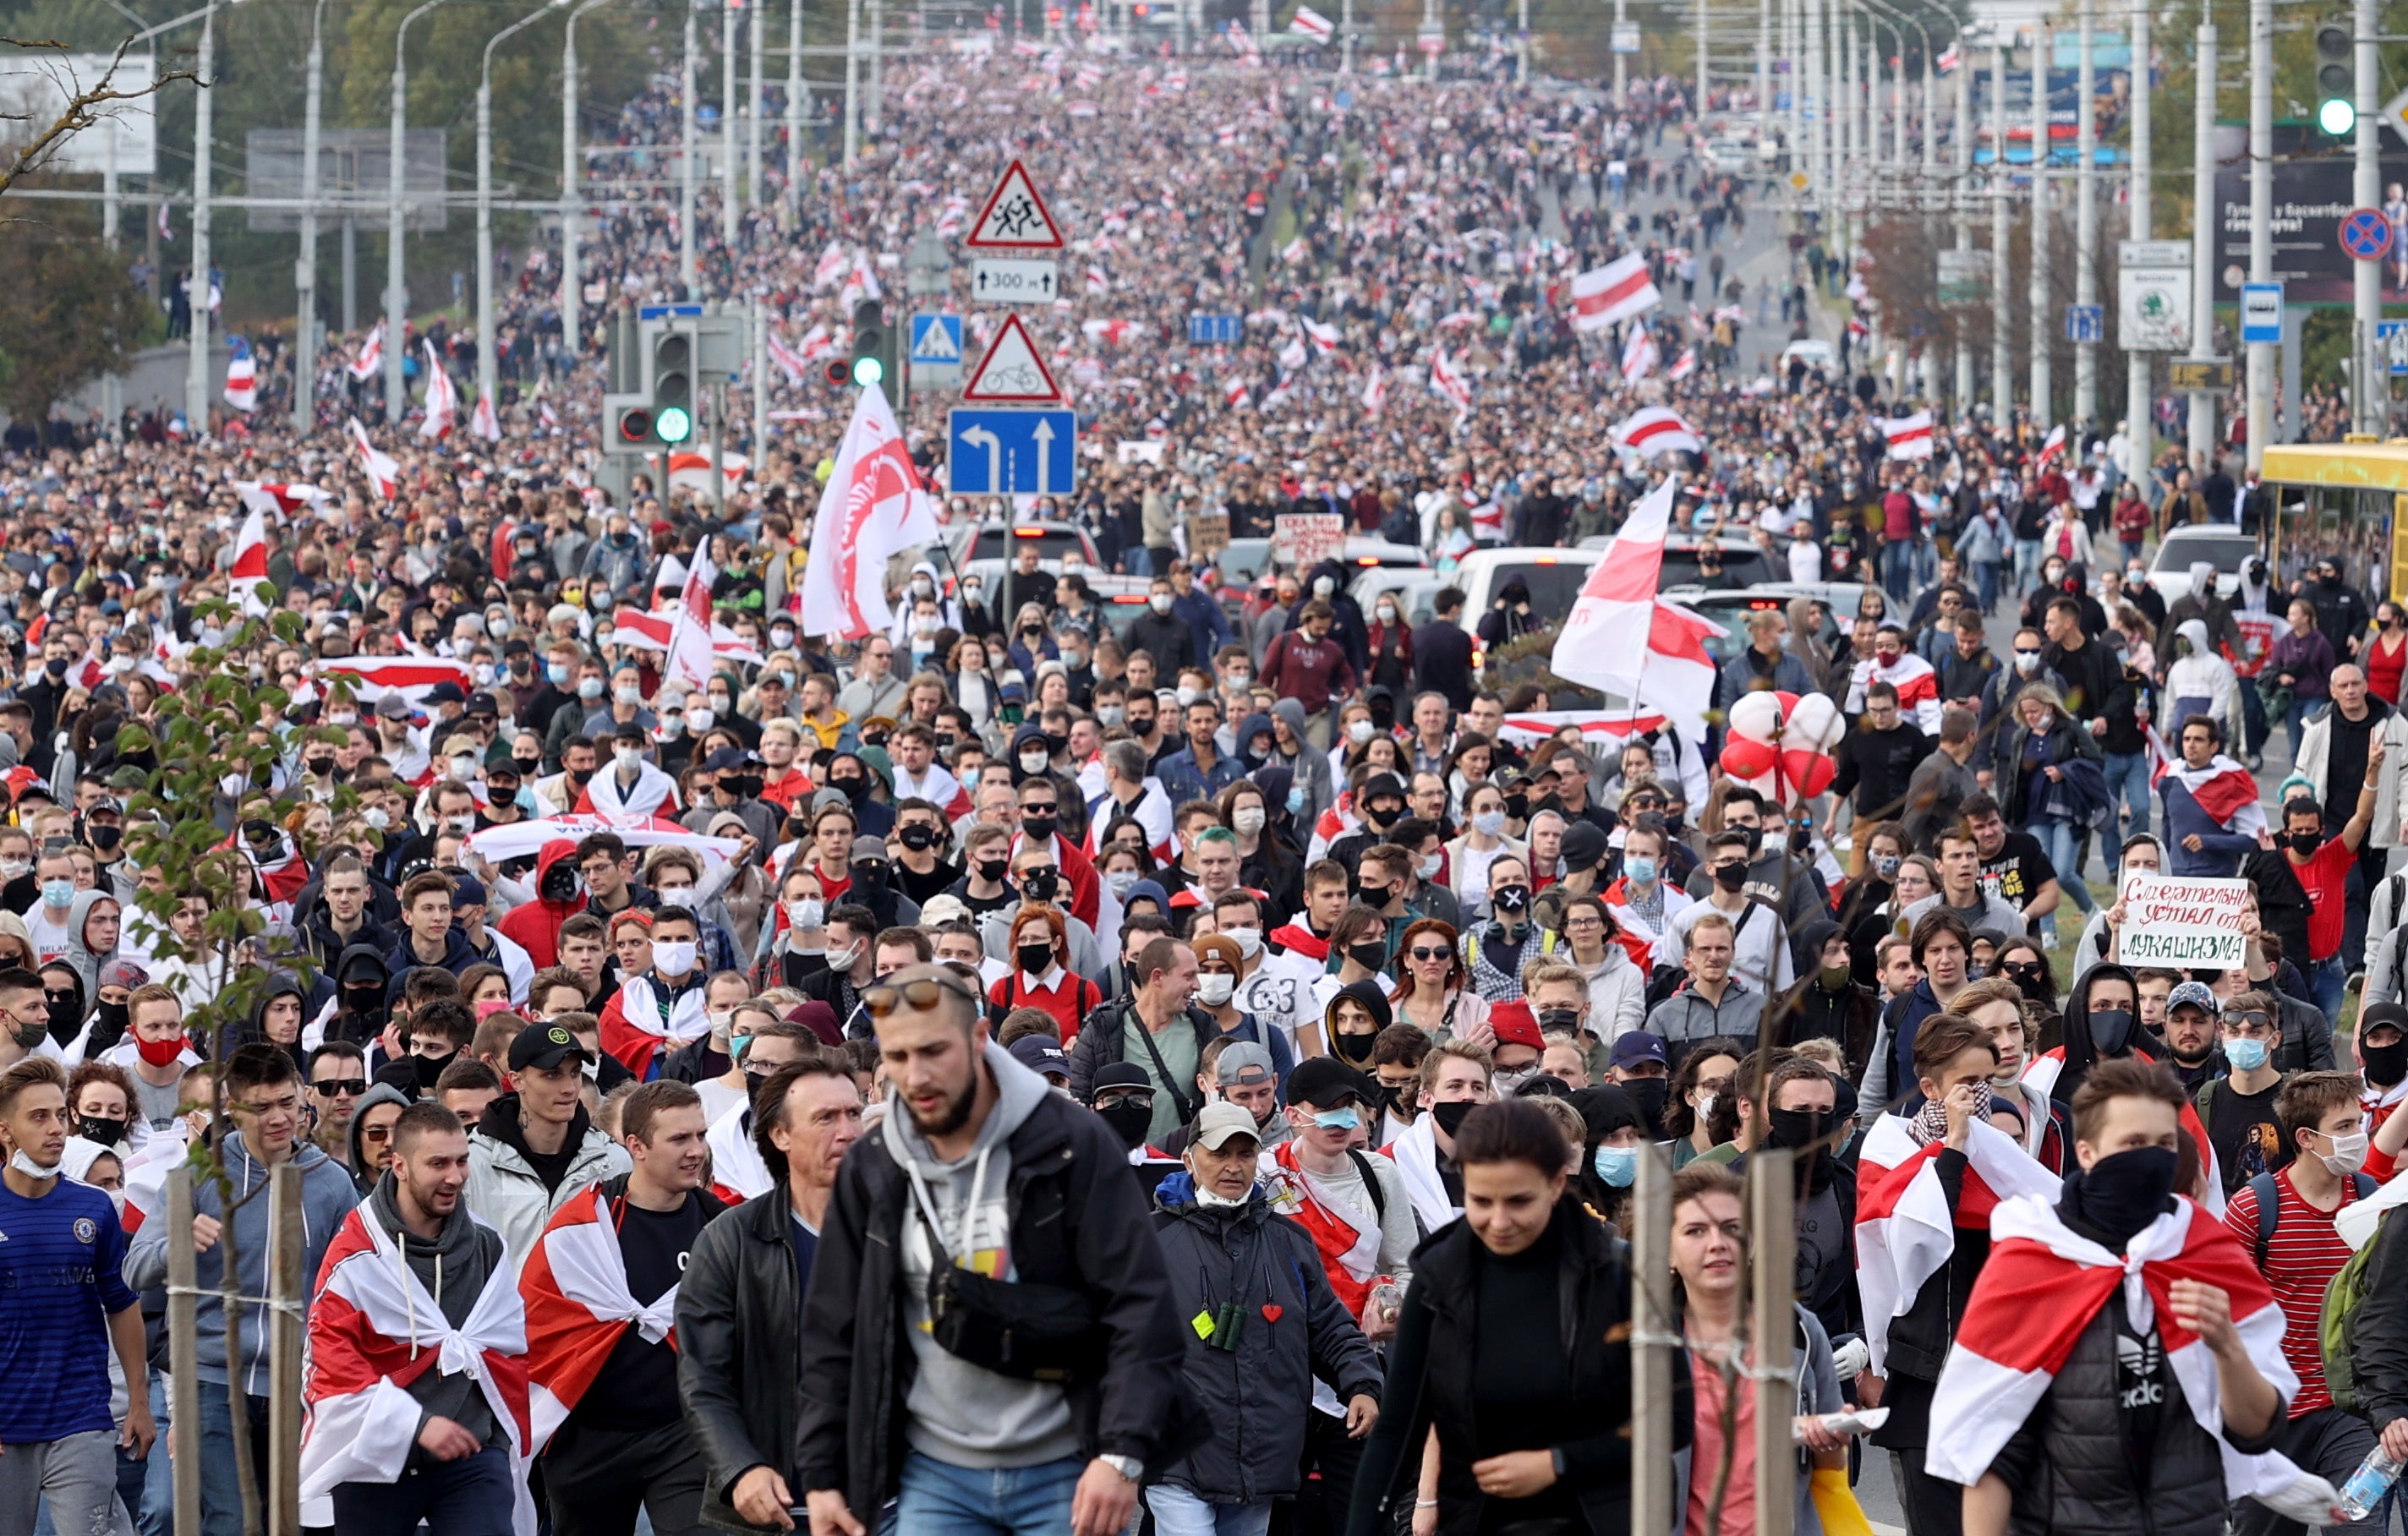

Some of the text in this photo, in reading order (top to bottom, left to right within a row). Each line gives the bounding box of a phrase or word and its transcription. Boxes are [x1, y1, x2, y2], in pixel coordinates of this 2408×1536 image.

[992, 272, 1022, 287] 300
[2125, 877, 2247, 909] Смертельно
[2121, 933, 2244, 961] ЛУКАШИЗМА
